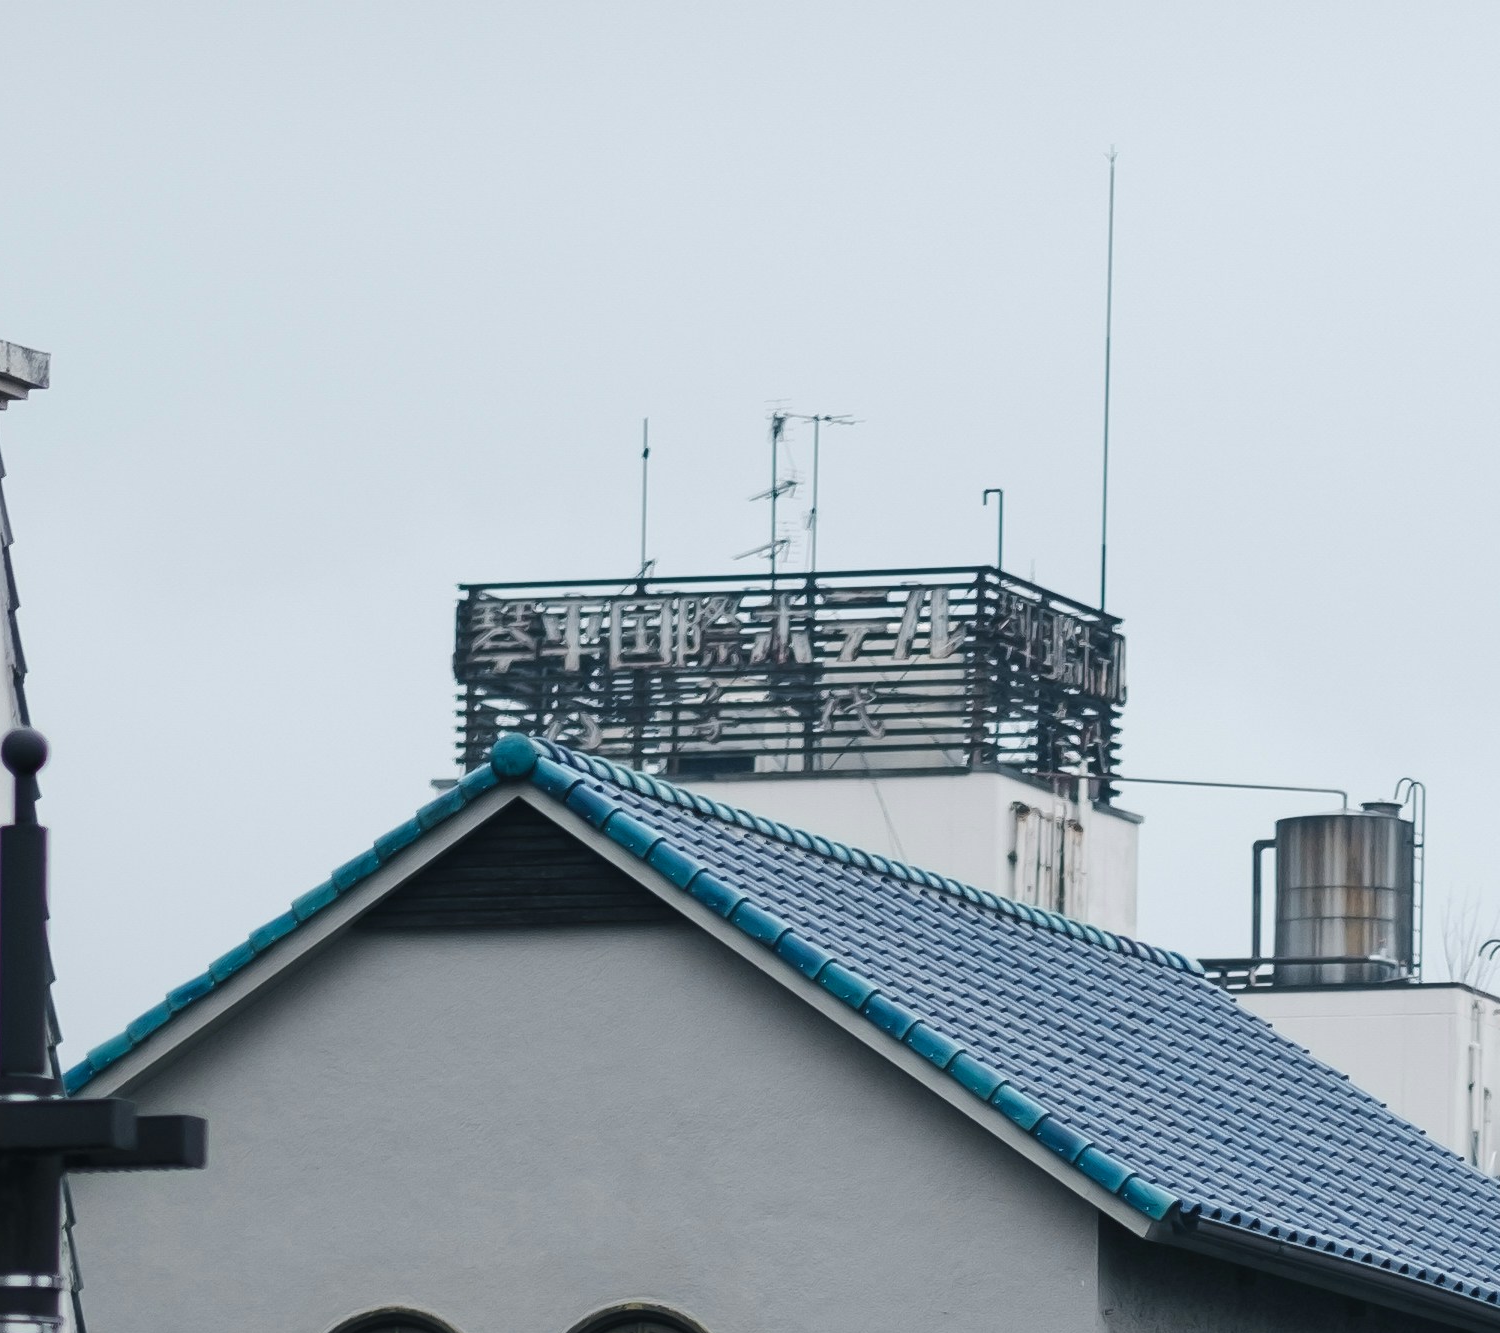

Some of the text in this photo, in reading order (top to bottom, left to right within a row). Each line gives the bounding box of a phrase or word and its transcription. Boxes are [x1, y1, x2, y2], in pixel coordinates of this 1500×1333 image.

[471, 587, 969, 673] 琴平国際ホテル
